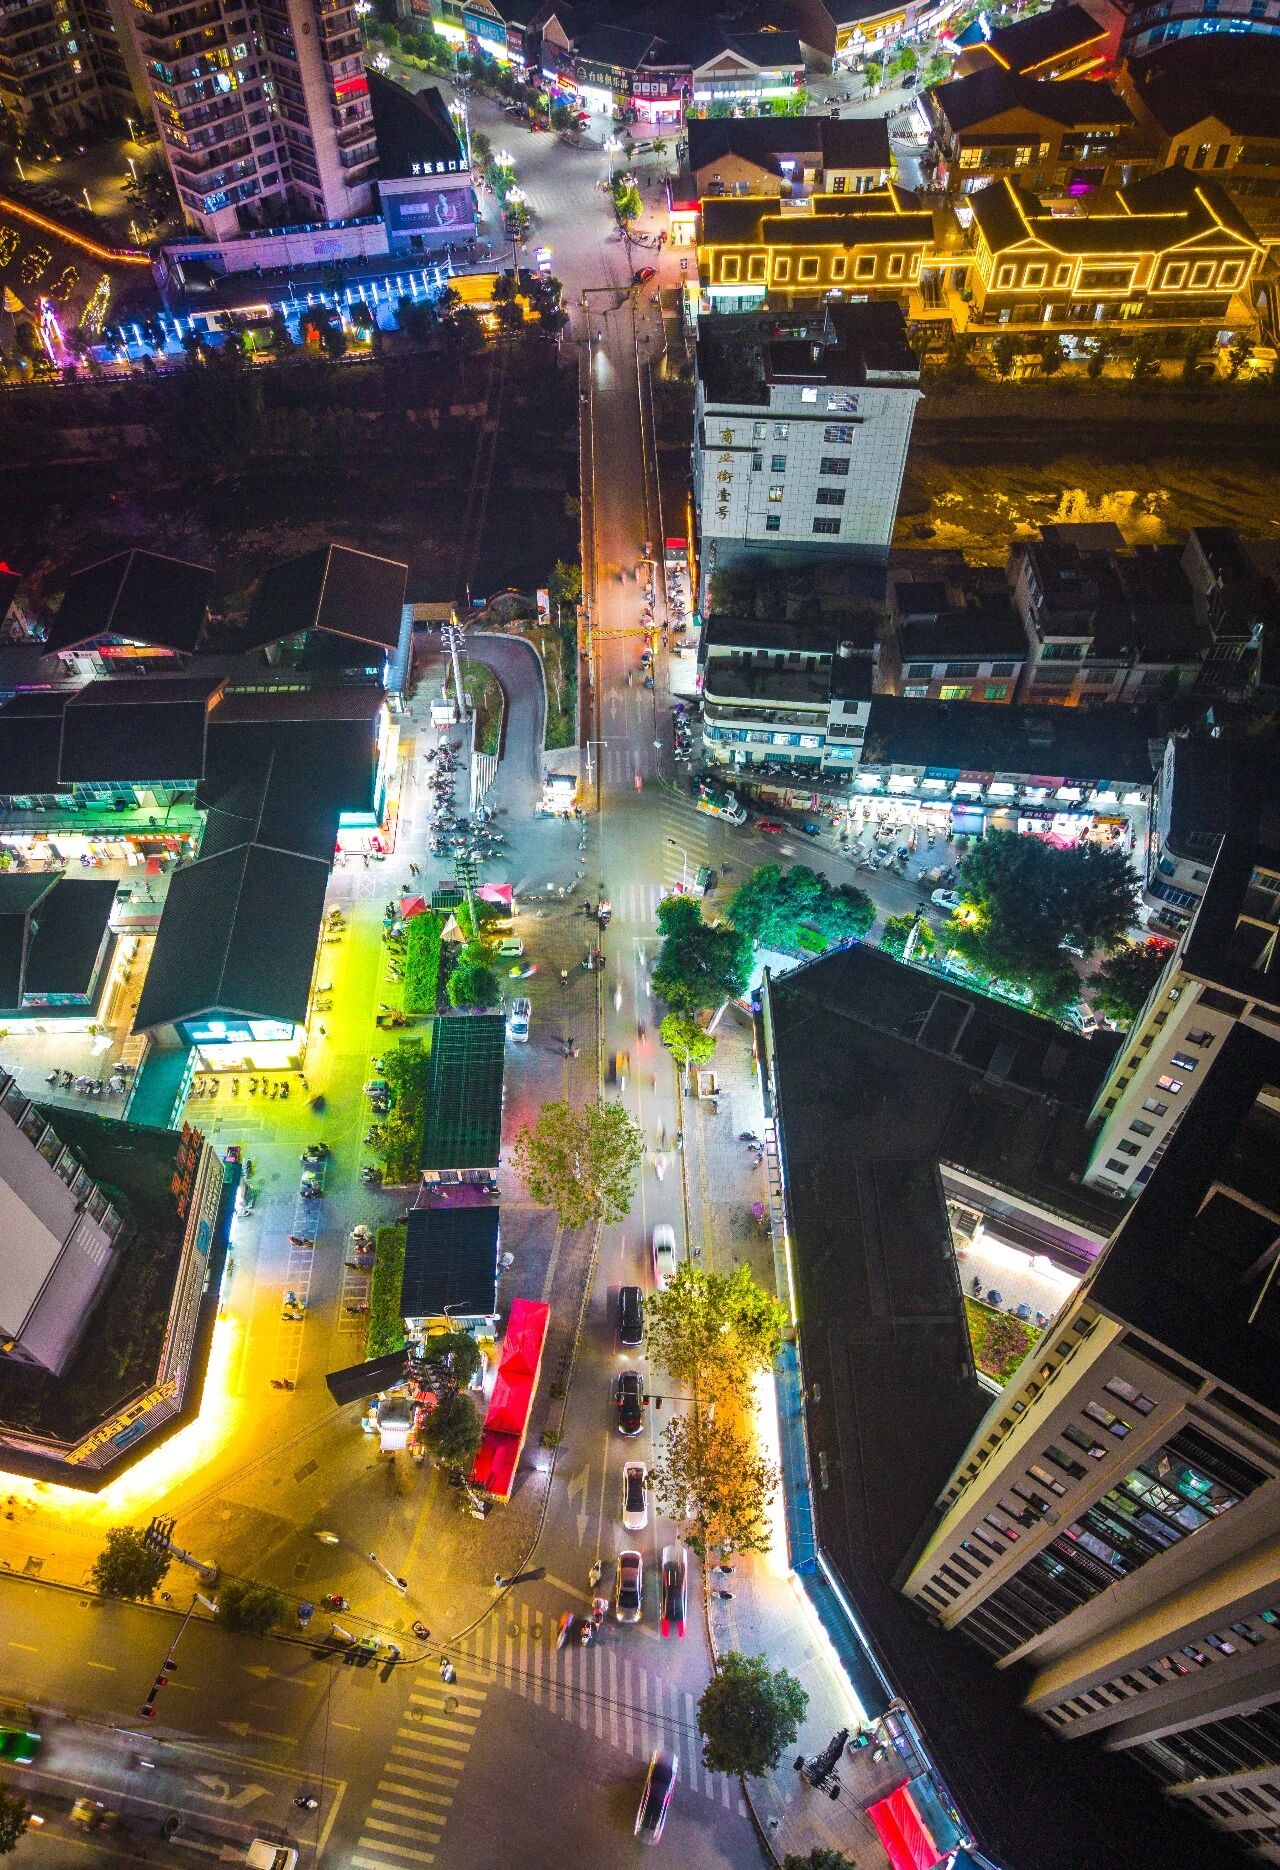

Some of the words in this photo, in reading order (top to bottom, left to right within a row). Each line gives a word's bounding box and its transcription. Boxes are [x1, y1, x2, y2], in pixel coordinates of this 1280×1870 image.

[588, 70, 629, 90] 台球俱乐部
[715, 427, 736, 520] 商业街壹号
